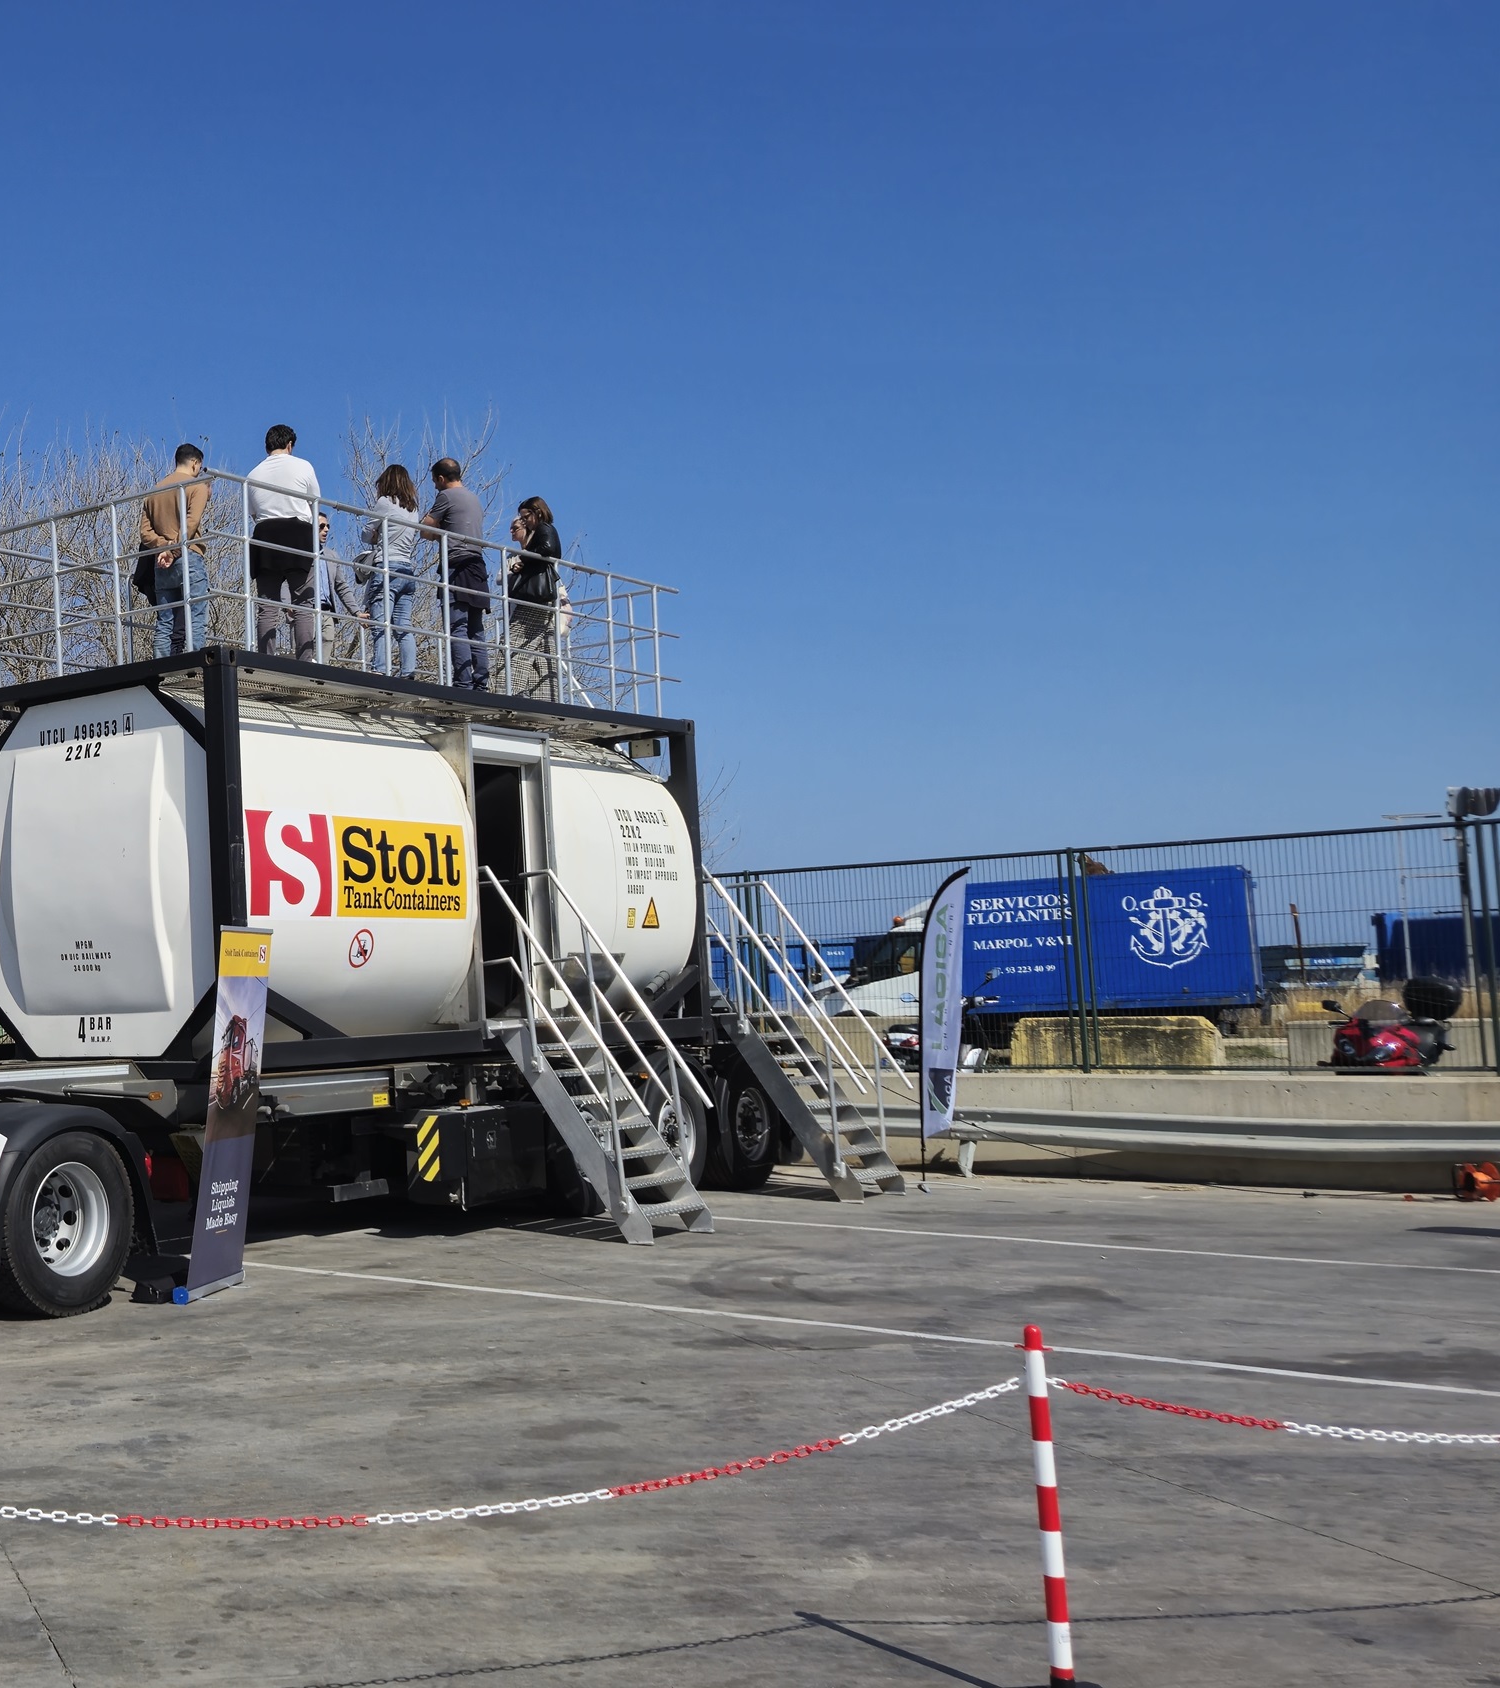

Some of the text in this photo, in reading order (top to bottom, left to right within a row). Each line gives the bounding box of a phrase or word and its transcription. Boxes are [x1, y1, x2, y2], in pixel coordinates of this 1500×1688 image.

[39, 728, 66, 747] UTCU
[74, 719, 117, 741] 496353
[65, 741, 102, 762] 22K2
[613, 808, 632, 822] UTCU
[634, 810, 660, 825] 496353
[620, 824, 642, 839] 22K2
[341, 825, 461, 887] Stolt
[640, 843, 662, 854] PORTABLE
[634, 869, 651, 880] IMPACT
[655, 870, 677, 881] APPROVED
[970, 893, 1069, 912] SERVICIOS
[966, 906, 1073, 926] FLOTANTES
[973, 937, 1033, 951] MARPOL
[81, 951, 112, 961] RAILWAYS
[1005, 966, 1016, 974] 93
[1017, 965, 1032, 974] 223
[1033, 965, 1044, 973] 40
[1045, 964, 1056, 972] 99
[78, 1016, 112, 1043] 4 BAR
[211, 1179, 239, 1195] Shipping
[211, 1195, 235, 1213] Liquids
[205, 1212, 238, 1230] Made Easy
